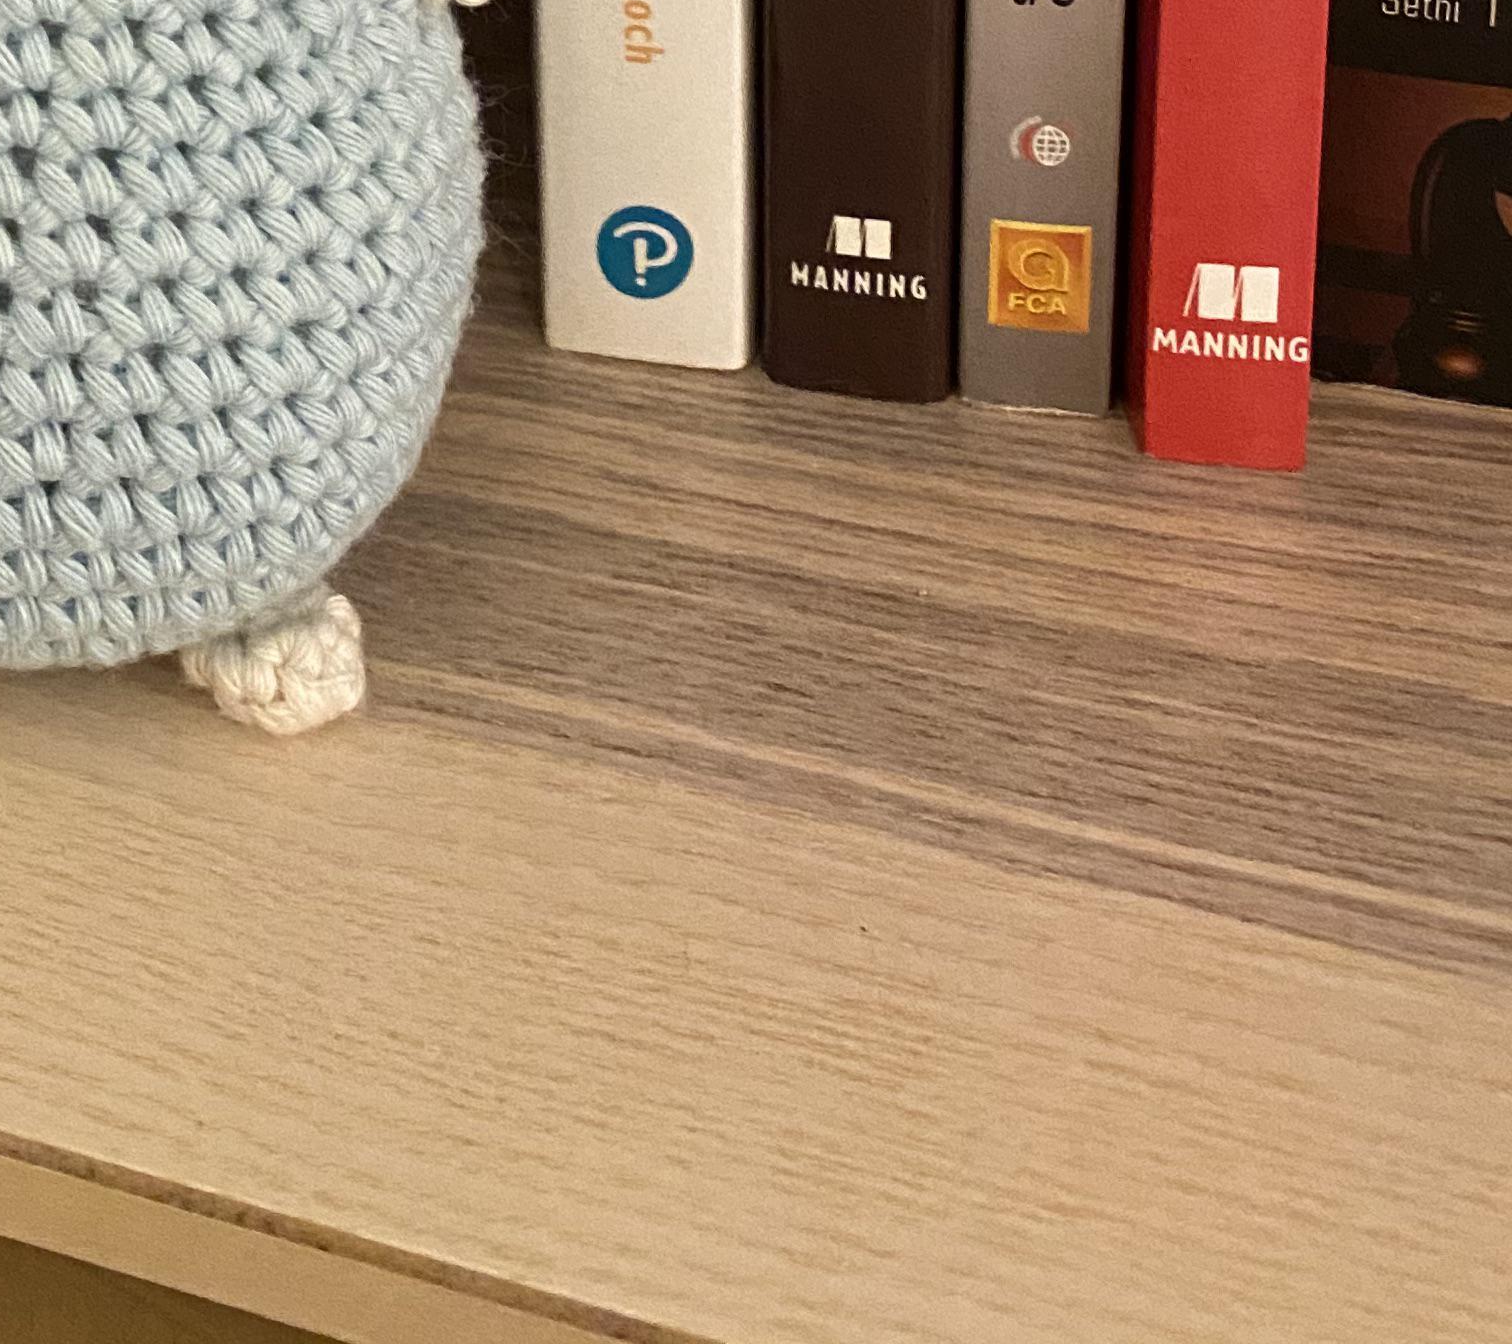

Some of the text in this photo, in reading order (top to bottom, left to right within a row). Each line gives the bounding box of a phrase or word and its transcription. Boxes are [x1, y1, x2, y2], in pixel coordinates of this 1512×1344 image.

[790, 260, 927, 301] MANNING
[1009, 293, 1066, 315] FCA
[1152, 327, 1309, 362] MANNING
